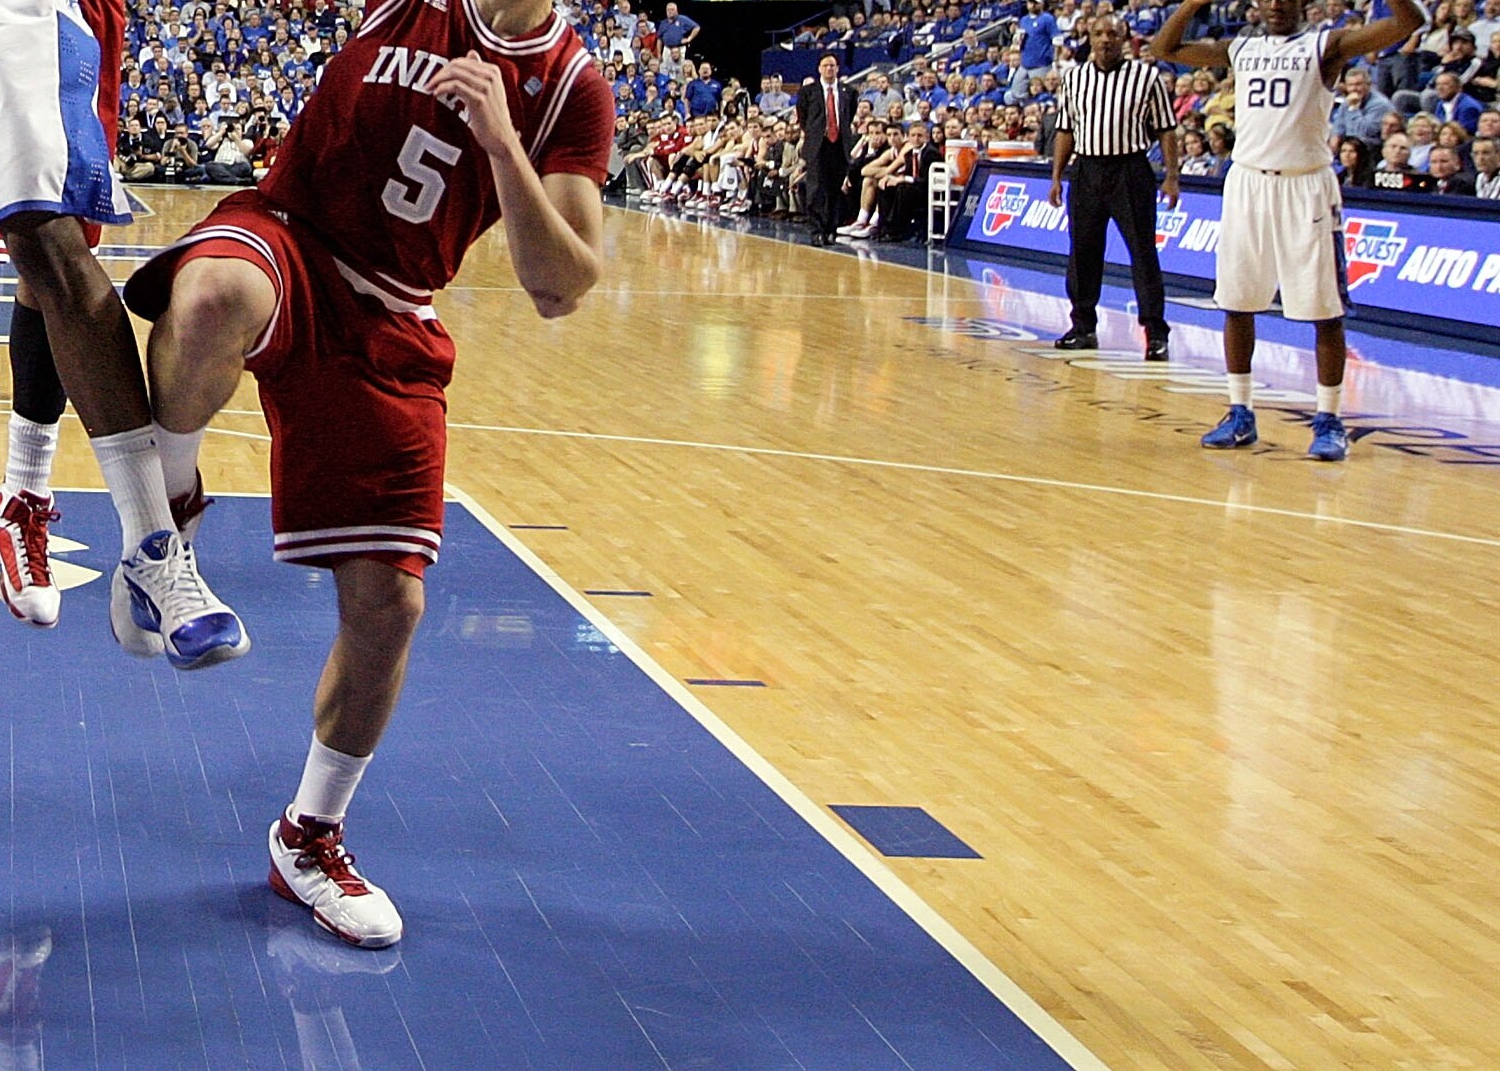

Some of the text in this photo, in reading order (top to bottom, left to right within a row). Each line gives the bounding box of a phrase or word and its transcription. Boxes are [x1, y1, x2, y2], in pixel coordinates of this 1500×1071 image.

[1237, 56, 1312, 72] KENTUCKY
[1248, 78, 1291, 108] 20
[381, 124, 462, 224] 5
[1374, 172, 1404, 188] POSS
[1397, 245, 1478, 288] AUTO
